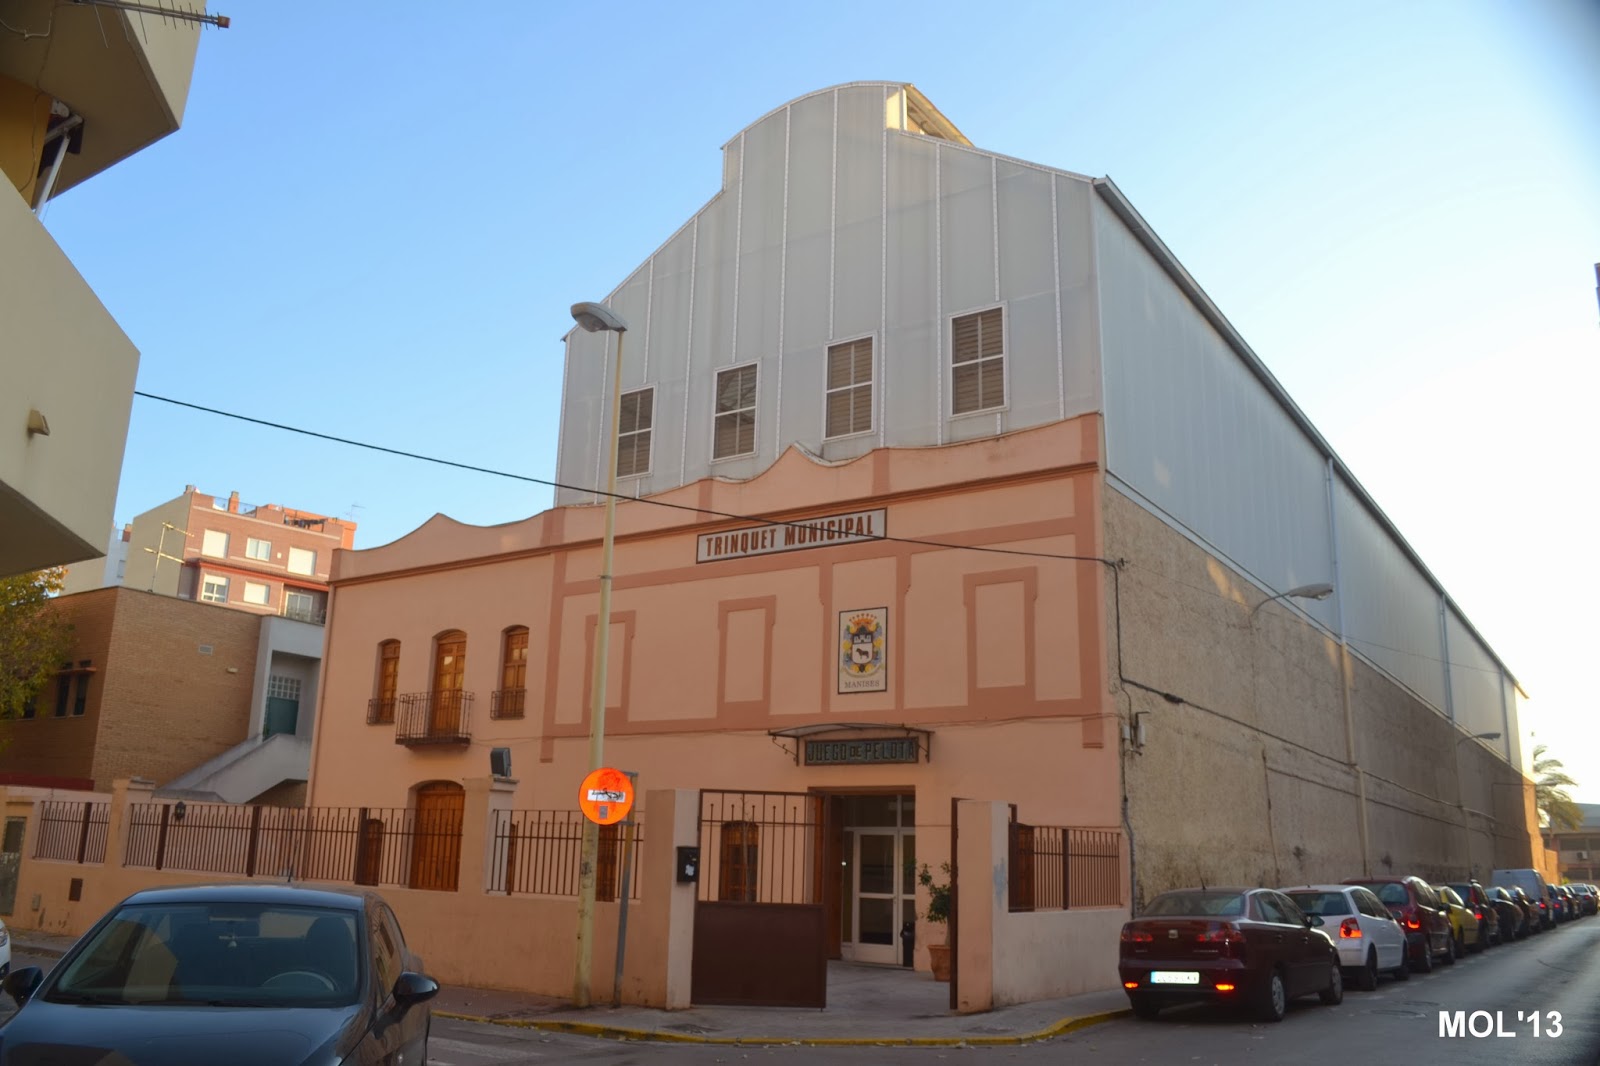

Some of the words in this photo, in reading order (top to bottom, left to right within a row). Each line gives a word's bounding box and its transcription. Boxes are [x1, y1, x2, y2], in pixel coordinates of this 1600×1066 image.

[706, 528, 777, 554] TRINQUET
[784, 515, 873, 546] MUNICIPAL
[844, 680, 880, 688] MANISES
[808, 743, 847, 761] JUEGO
[865, 741, 915, 760] PELOTA
